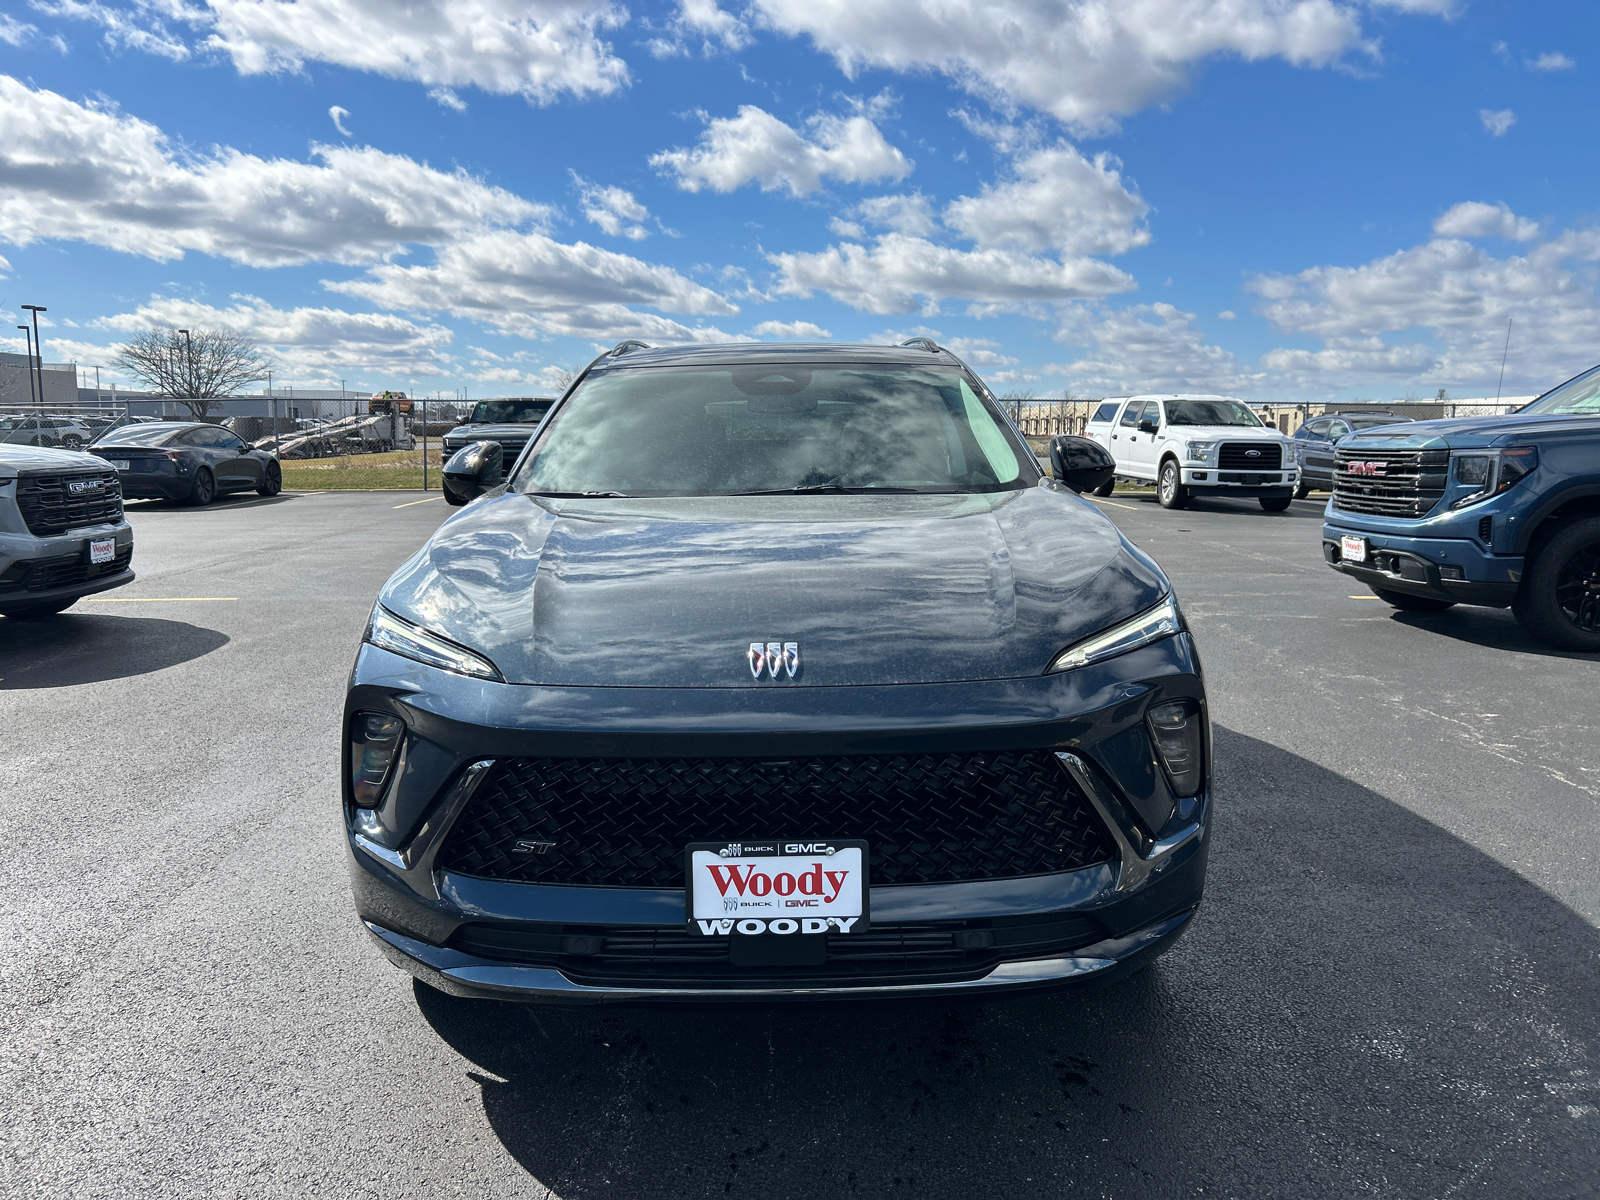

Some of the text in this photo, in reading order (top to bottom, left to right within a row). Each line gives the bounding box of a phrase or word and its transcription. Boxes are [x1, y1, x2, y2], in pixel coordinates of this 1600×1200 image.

[1348, 461, 1388, 476] GMC
[69, 481, 105, 494] GMC
[92, 543, 112, 553] Woody
[512, 841, 556, 854] ST
[785, 843, 827, 853] GMC
[706, 863, 849, 903] Woody
[697, 918, 859, 935] WOODY
